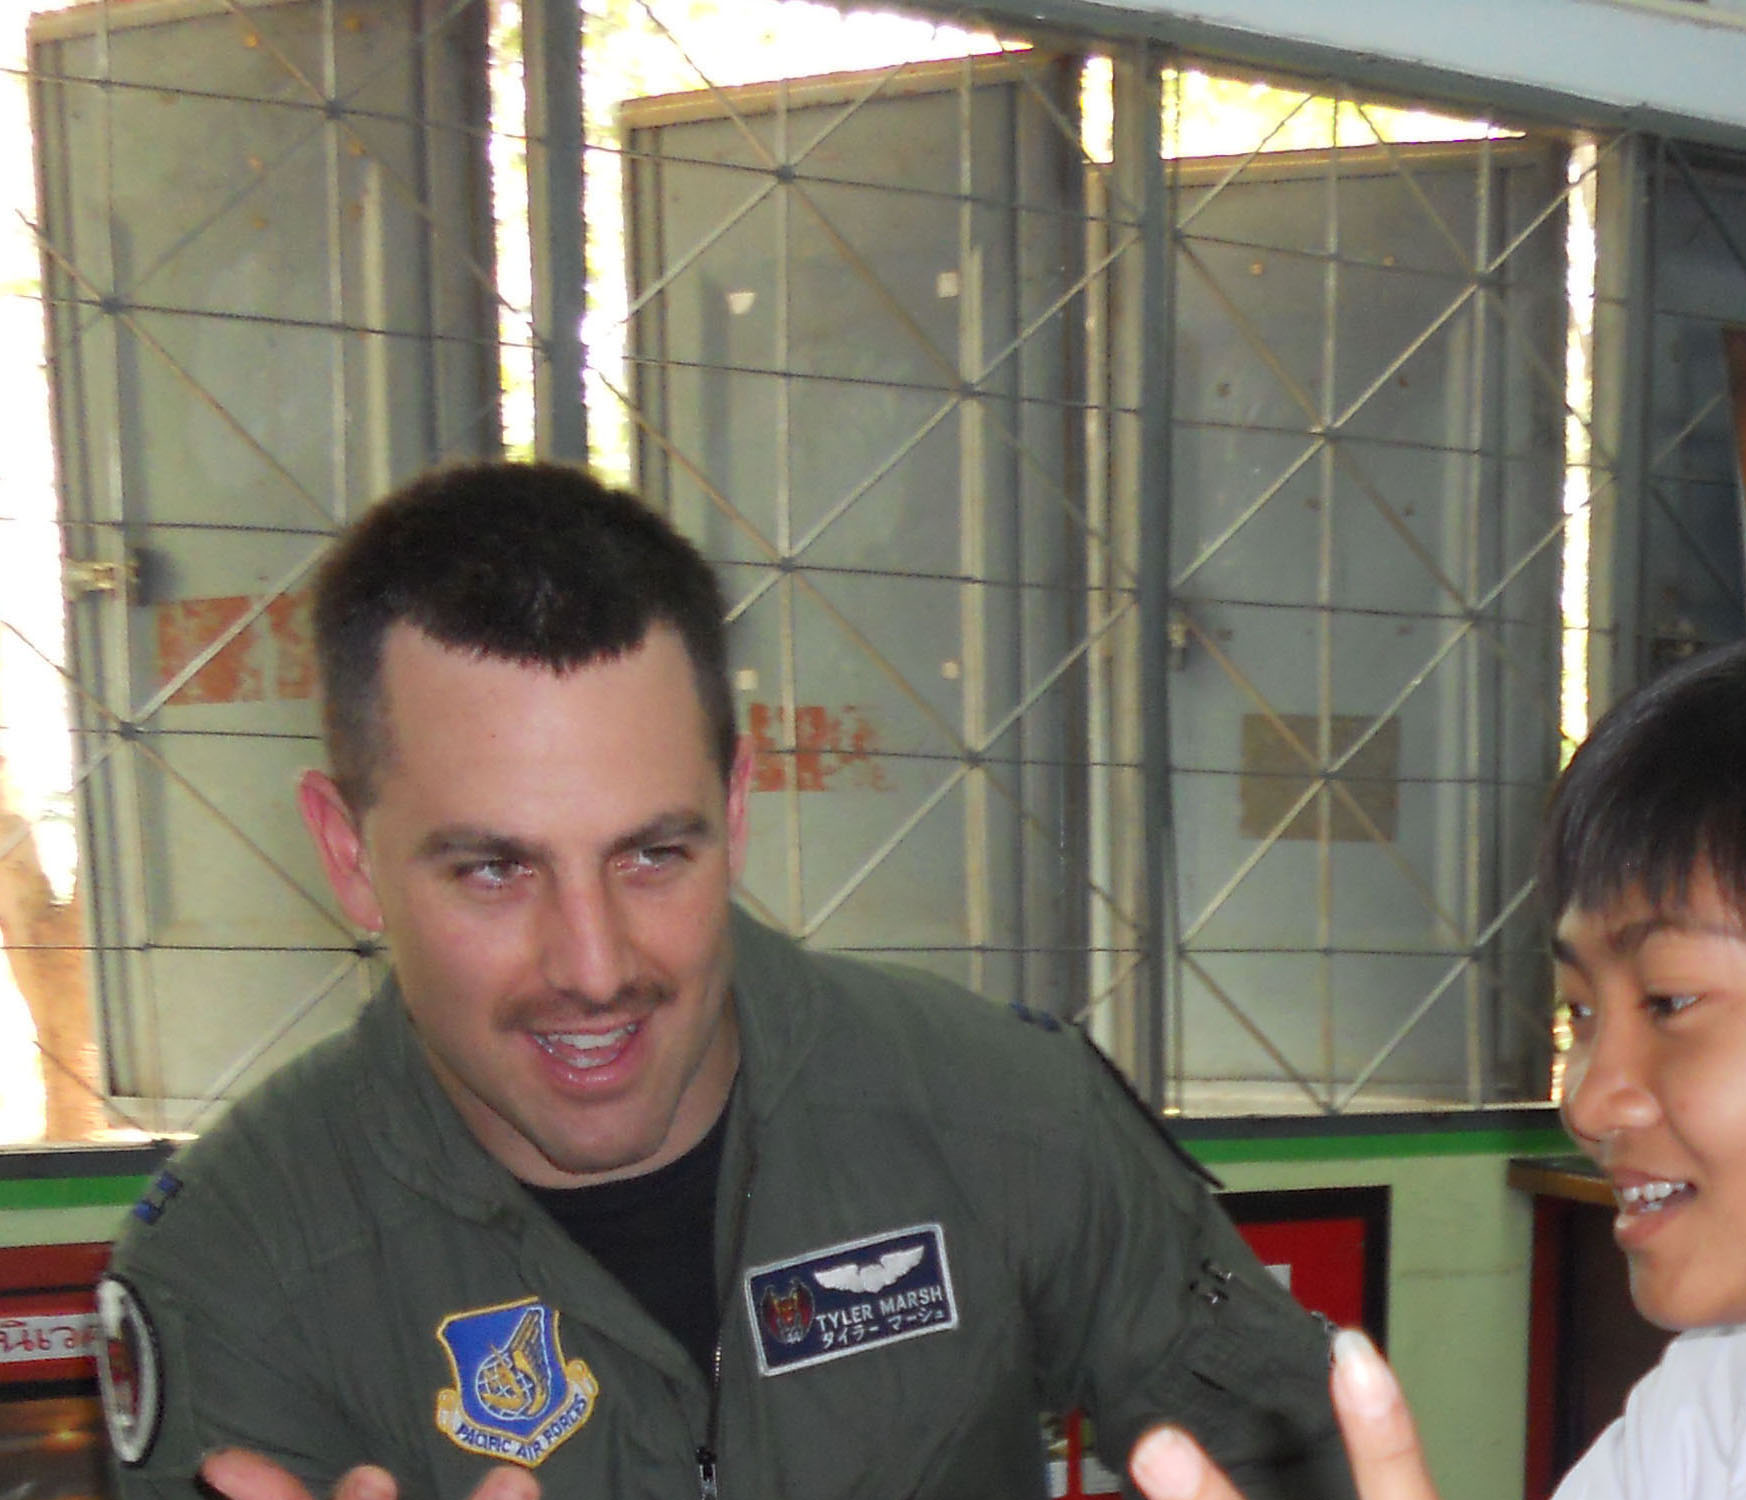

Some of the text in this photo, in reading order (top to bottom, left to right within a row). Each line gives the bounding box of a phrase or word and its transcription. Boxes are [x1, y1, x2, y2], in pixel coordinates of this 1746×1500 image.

[816, 1286, 943, 1331] TYLER MARSH
[822, 1325, 880, 1349] タイラー
[455, 1393, 587, 1461] PACIFIC AIR FORCES
